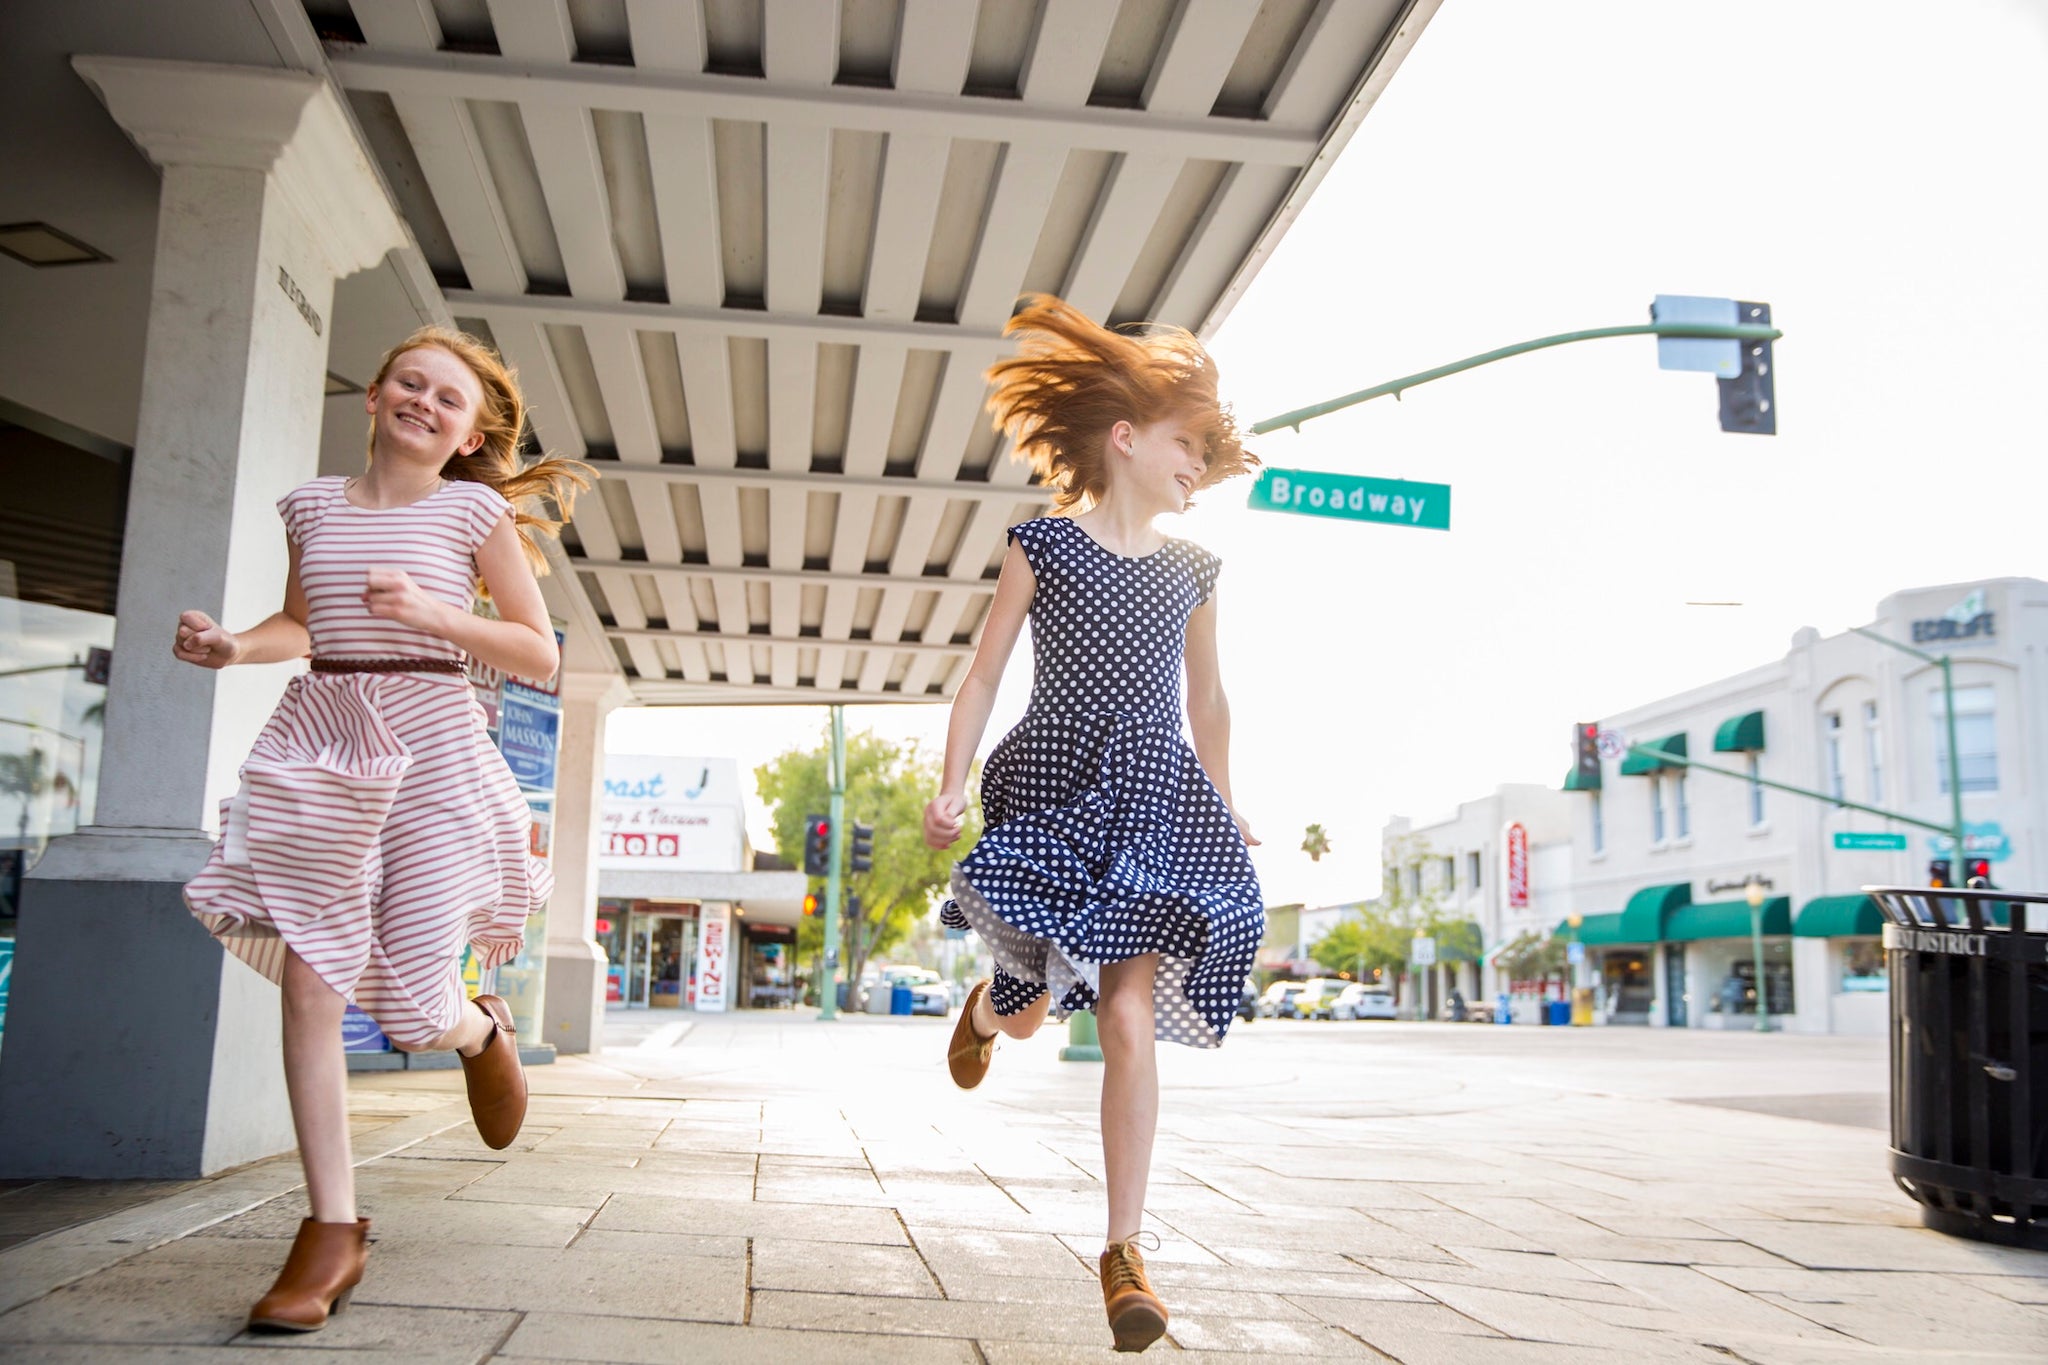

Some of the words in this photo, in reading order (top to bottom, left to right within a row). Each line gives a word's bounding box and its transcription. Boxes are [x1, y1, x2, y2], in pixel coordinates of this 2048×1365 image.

[1269, 475, 1426, 523] Broadway
[511, 683, 550, 704] MAYOR
[504, 704, 533, 724] JOHN
[504, 725, 555, 752] MASSON
[647, 807, 710, 826] Vacuum
[1916, 930, 1989, 957] DISTRICT
[702, 921, 724, 997] SEWING
